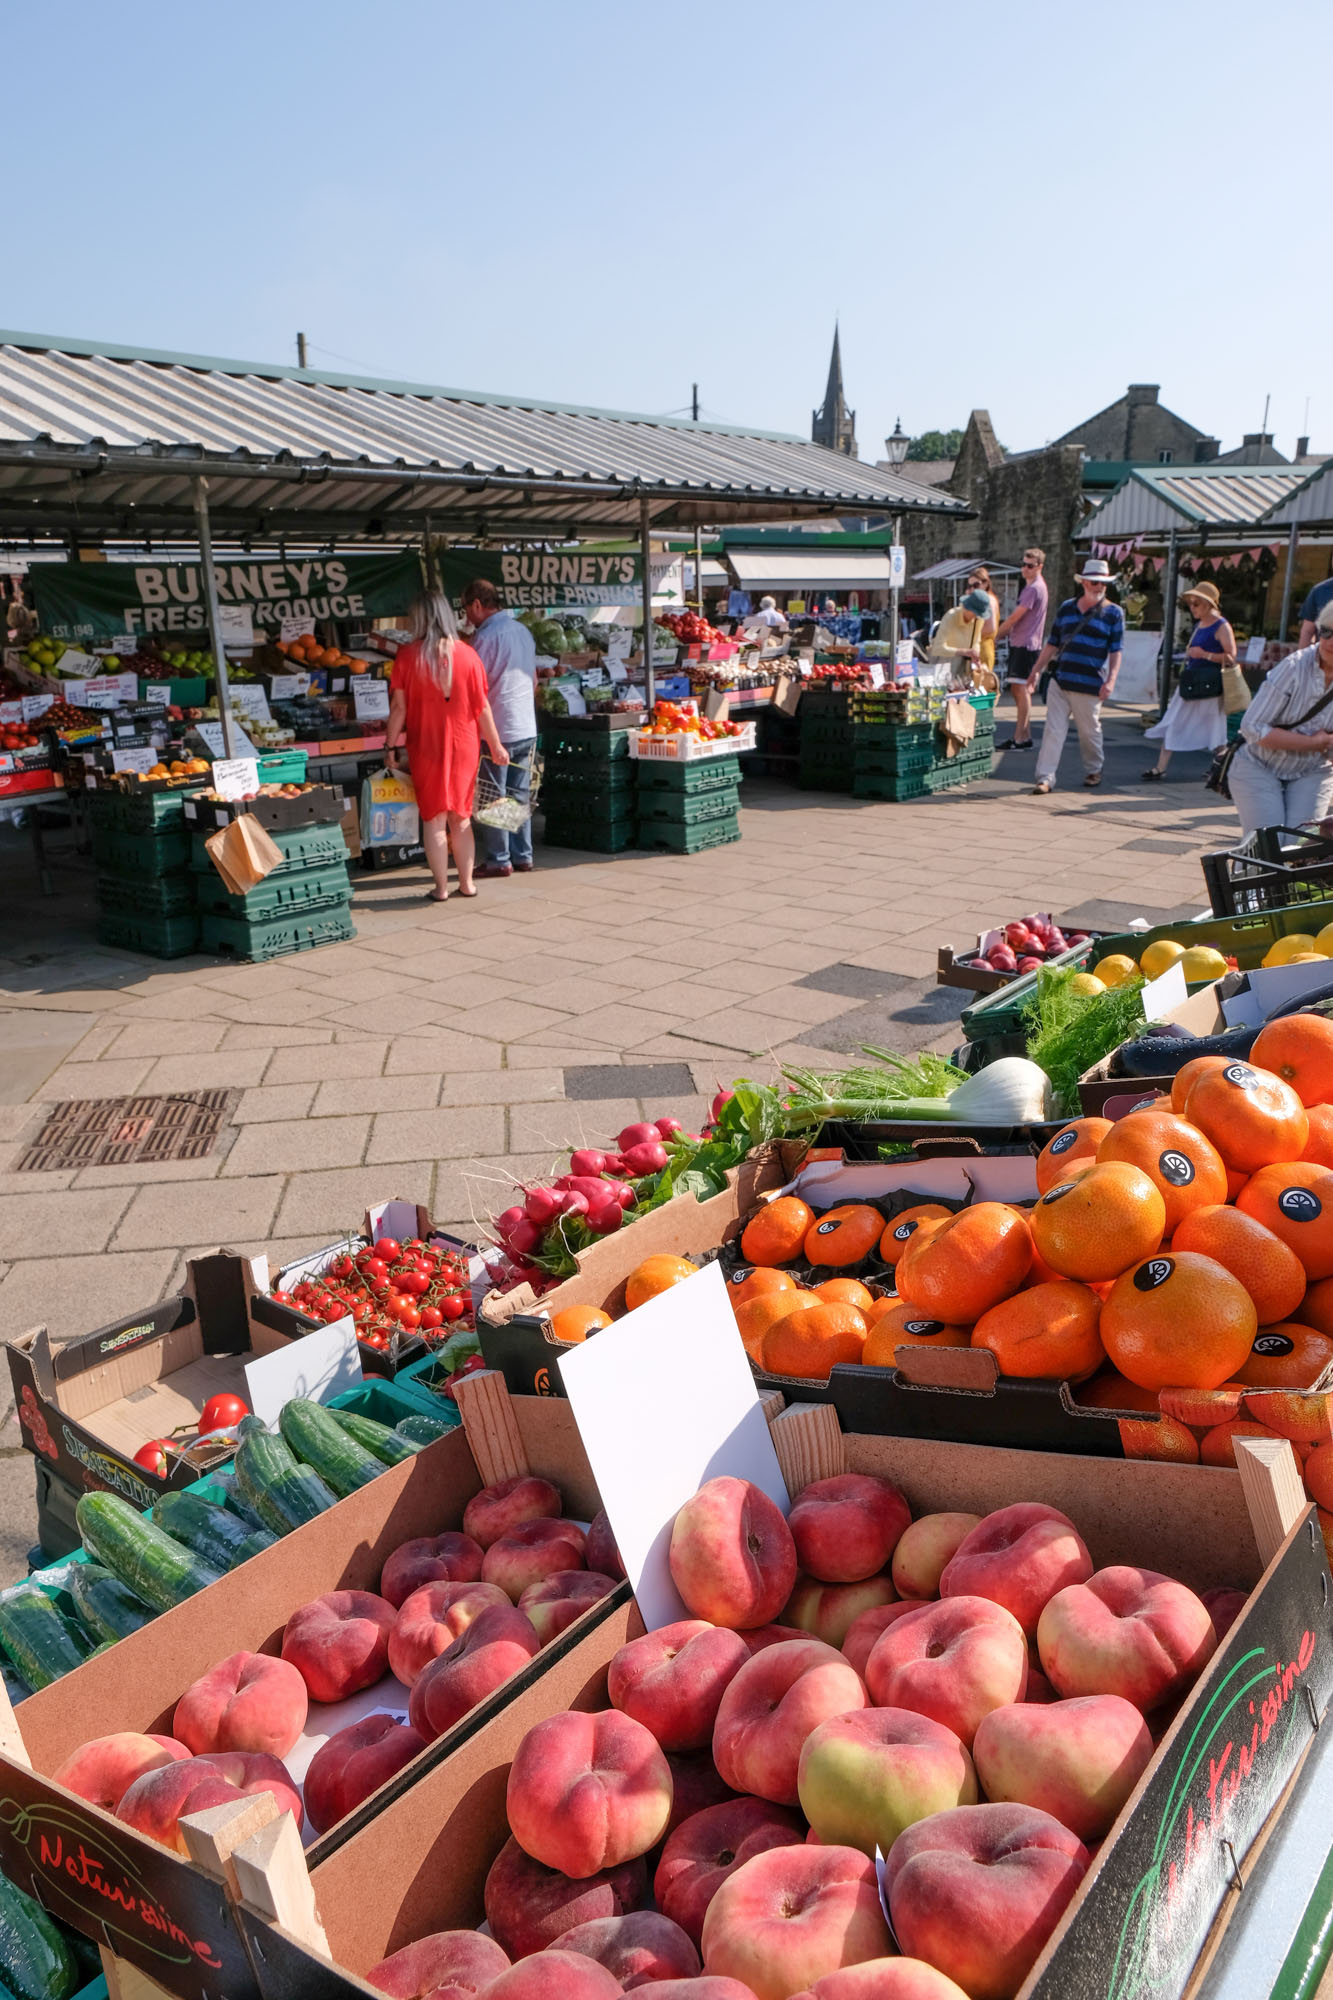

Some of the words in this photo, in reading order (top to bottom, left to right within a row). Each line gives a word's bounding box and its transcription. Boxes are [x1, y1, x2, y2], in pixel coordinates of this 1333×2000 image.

[135, 561, 348, 603] BURNEY'S
[502, 555, 635, 584] BURNEY'S
[564, 585, 643, 606] PRODUCE
[73, 624, 94, 636] 1949
[124, 605, 209, 633] FRES
[62, 1424, 162, 1509] SENSATIO
